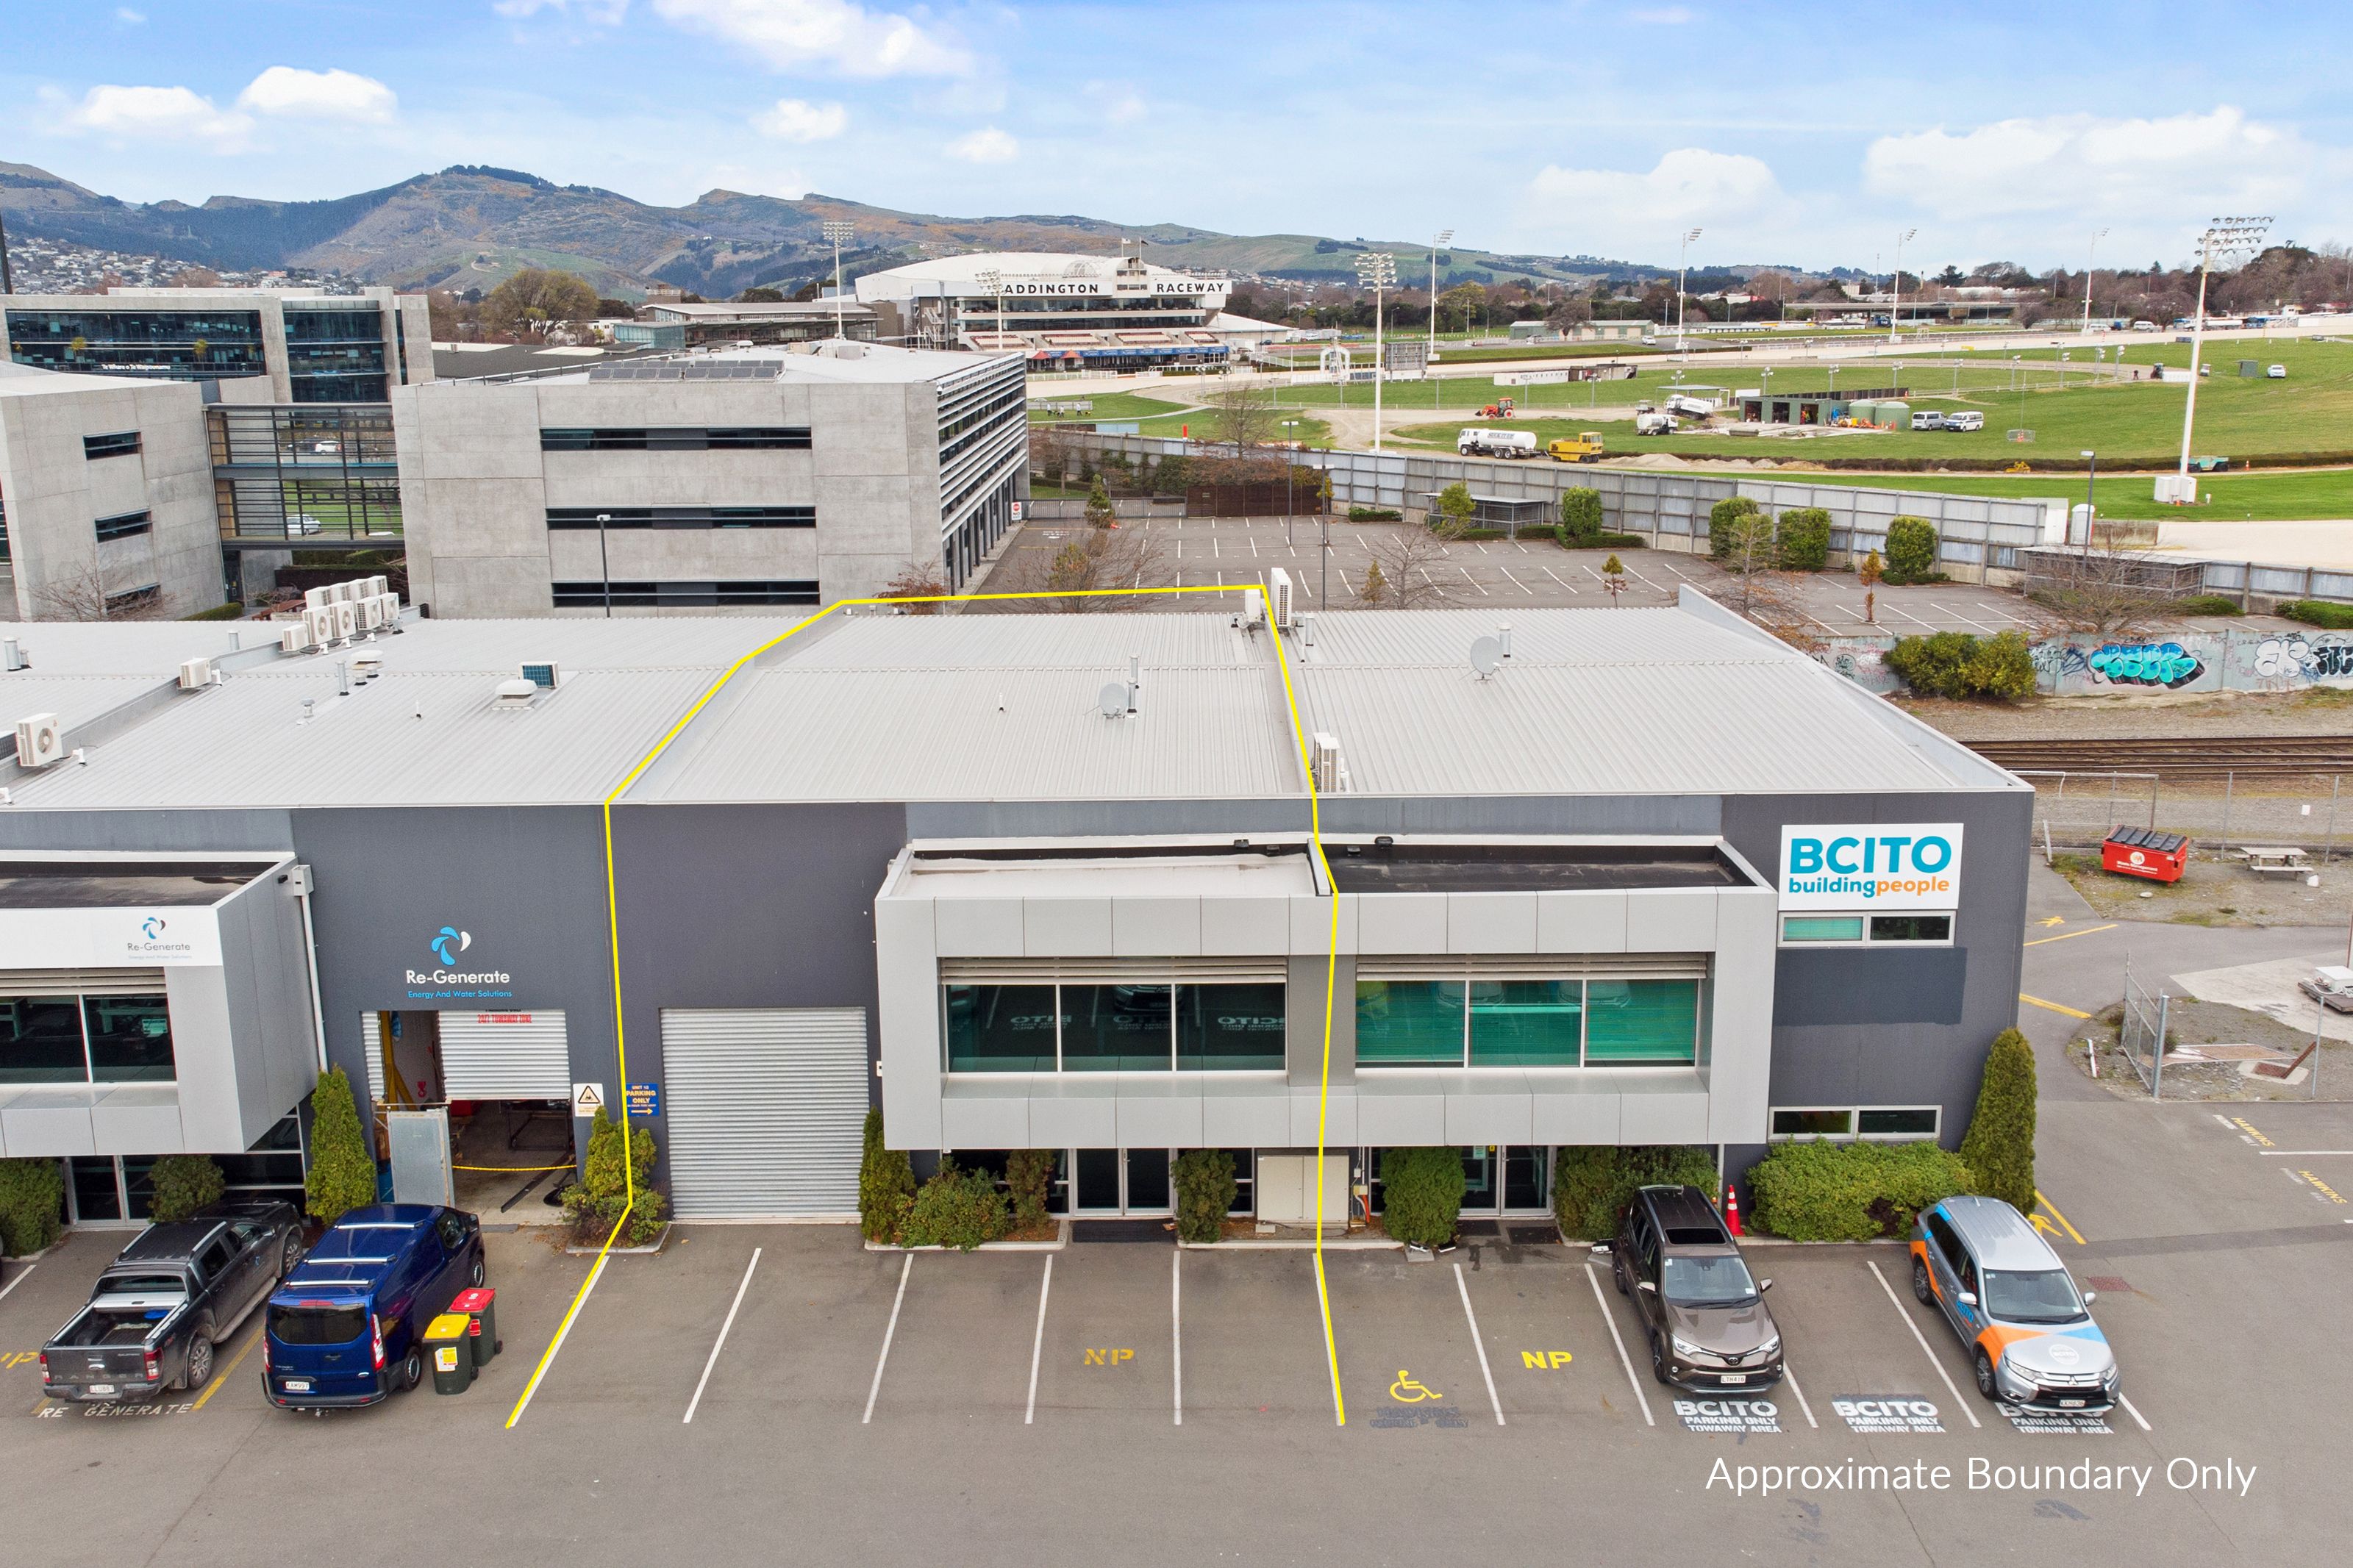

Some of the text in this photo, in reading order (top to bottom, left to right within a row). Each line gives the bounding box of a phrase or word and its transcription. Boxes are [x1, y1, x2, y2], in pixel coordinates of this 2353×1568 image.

[1005, 283, 1224, 294] ADDINGTON RACEWAY
[1790, 836, 1952, 875] BCITO
[127, 942, 191, 951] Re-Generate
[406, 970, 510, 984] Re-Generate
[408, 991, 433, 999] Energy
[477, 989, 513, 998] Solutions
[2231, 1117, 2276, 1147] HAWKINS
[2298, 1170, 2348, 1204] HAWKINS
[1085, 1348, 1134, 1365] NP
[1521, 1351, 1573, 1369] NP
[38, 1403, 194, 1418] RE GENERATE
[1673, 1400, 1778, 1417] BCITO
[1832, 1401, 1938, 1417] BCITO
[1684, 1417, 1777, 1425] PARKING ONLY
[1846, 1417, 1939, 1425] PARKING ONLY
[2010, 1417, 2106, 1426] PARKING ONLY
[1688, 1425, 1782, 1433] TOWAWAY AREA
[1852, 1425, 1910, 1433] TOWAWAY
[2081, 1426, 2115, 1434] AREA
